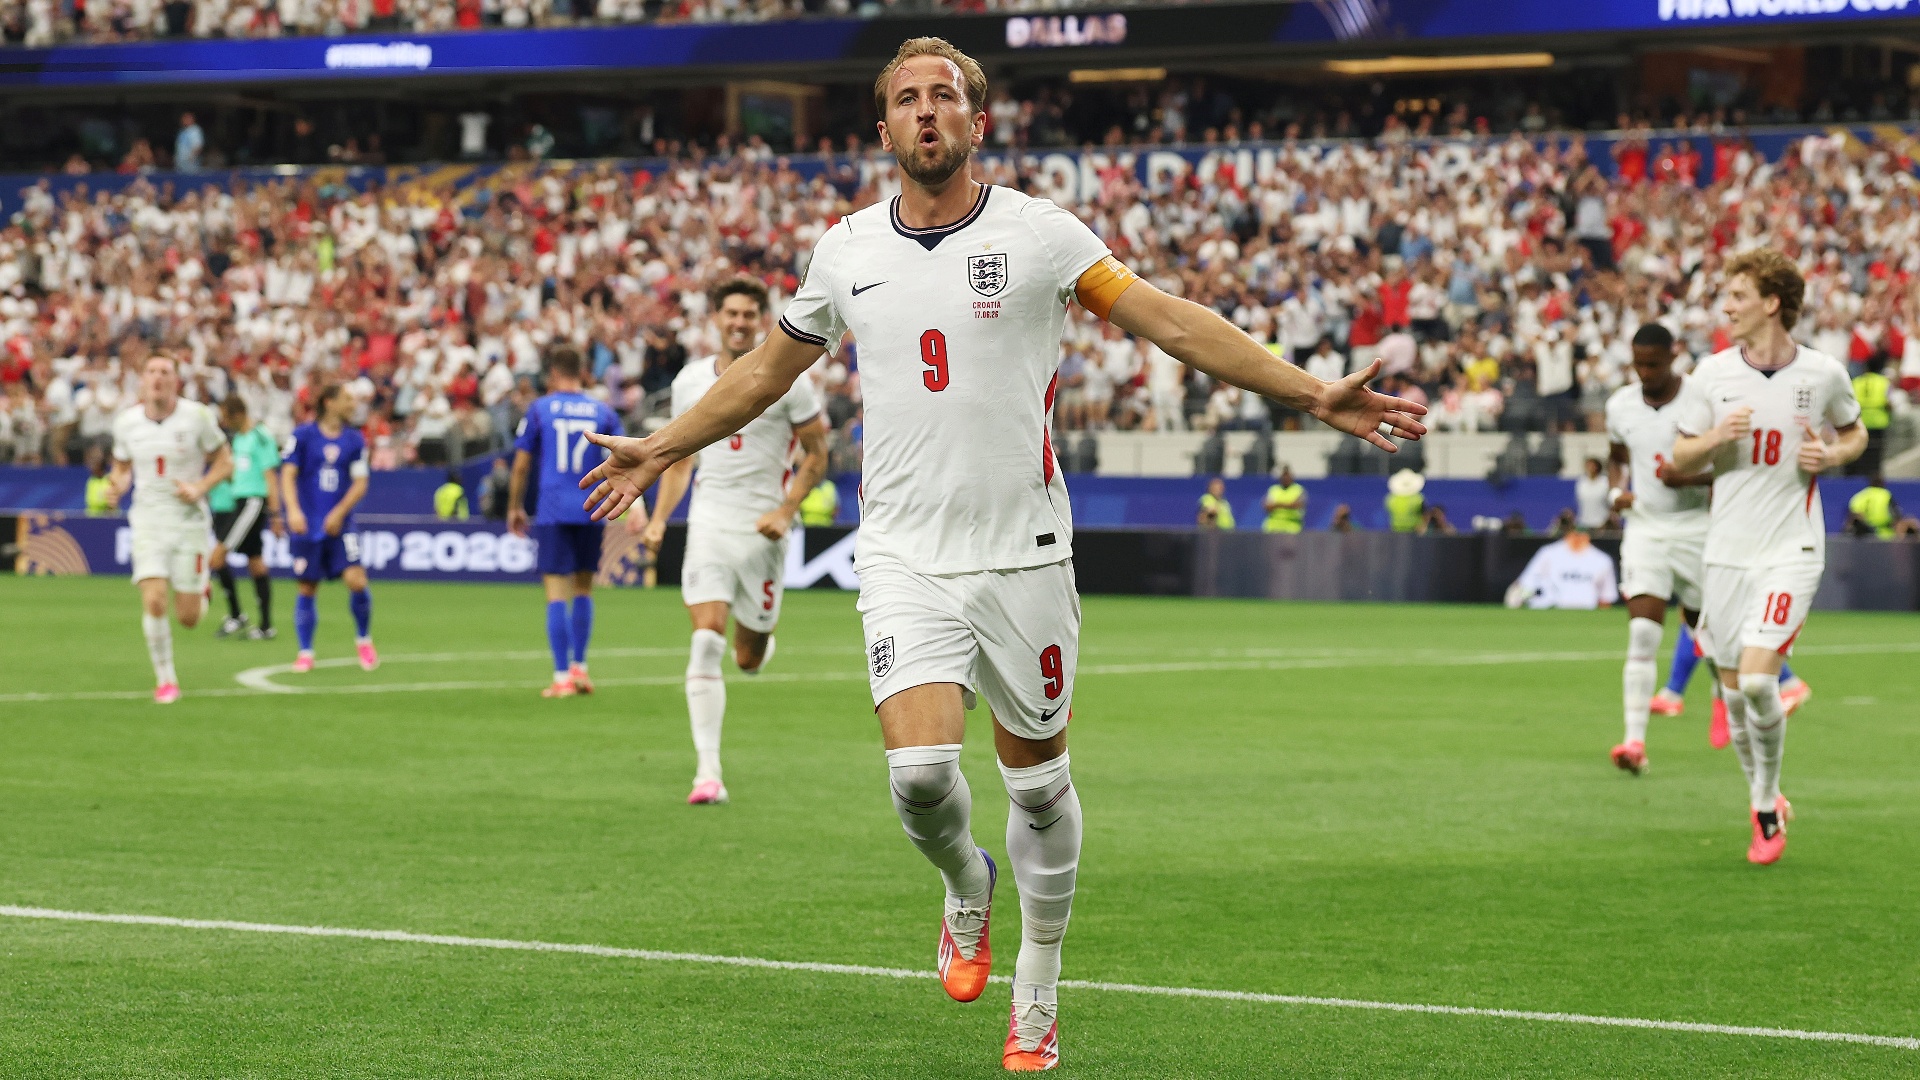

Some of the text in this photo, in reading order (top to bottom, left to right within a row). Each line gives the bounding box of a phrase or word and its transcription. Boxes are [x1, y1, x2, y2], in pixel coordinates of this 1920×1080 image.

[1005, 13, 1127, 48] DALLAS
[972, 301, 1001, 309] CROATIA
[920, 329, 949, 392] 9
[553, 418, 597, 473] 17
[1752, 428, 1783, 466] 18
[401, 531, 535, 573] 2026
[762, 579, 775, 611] 5
[1763, 592, 1792, 626] 18
[1039, 644, 1064, 700] 9
